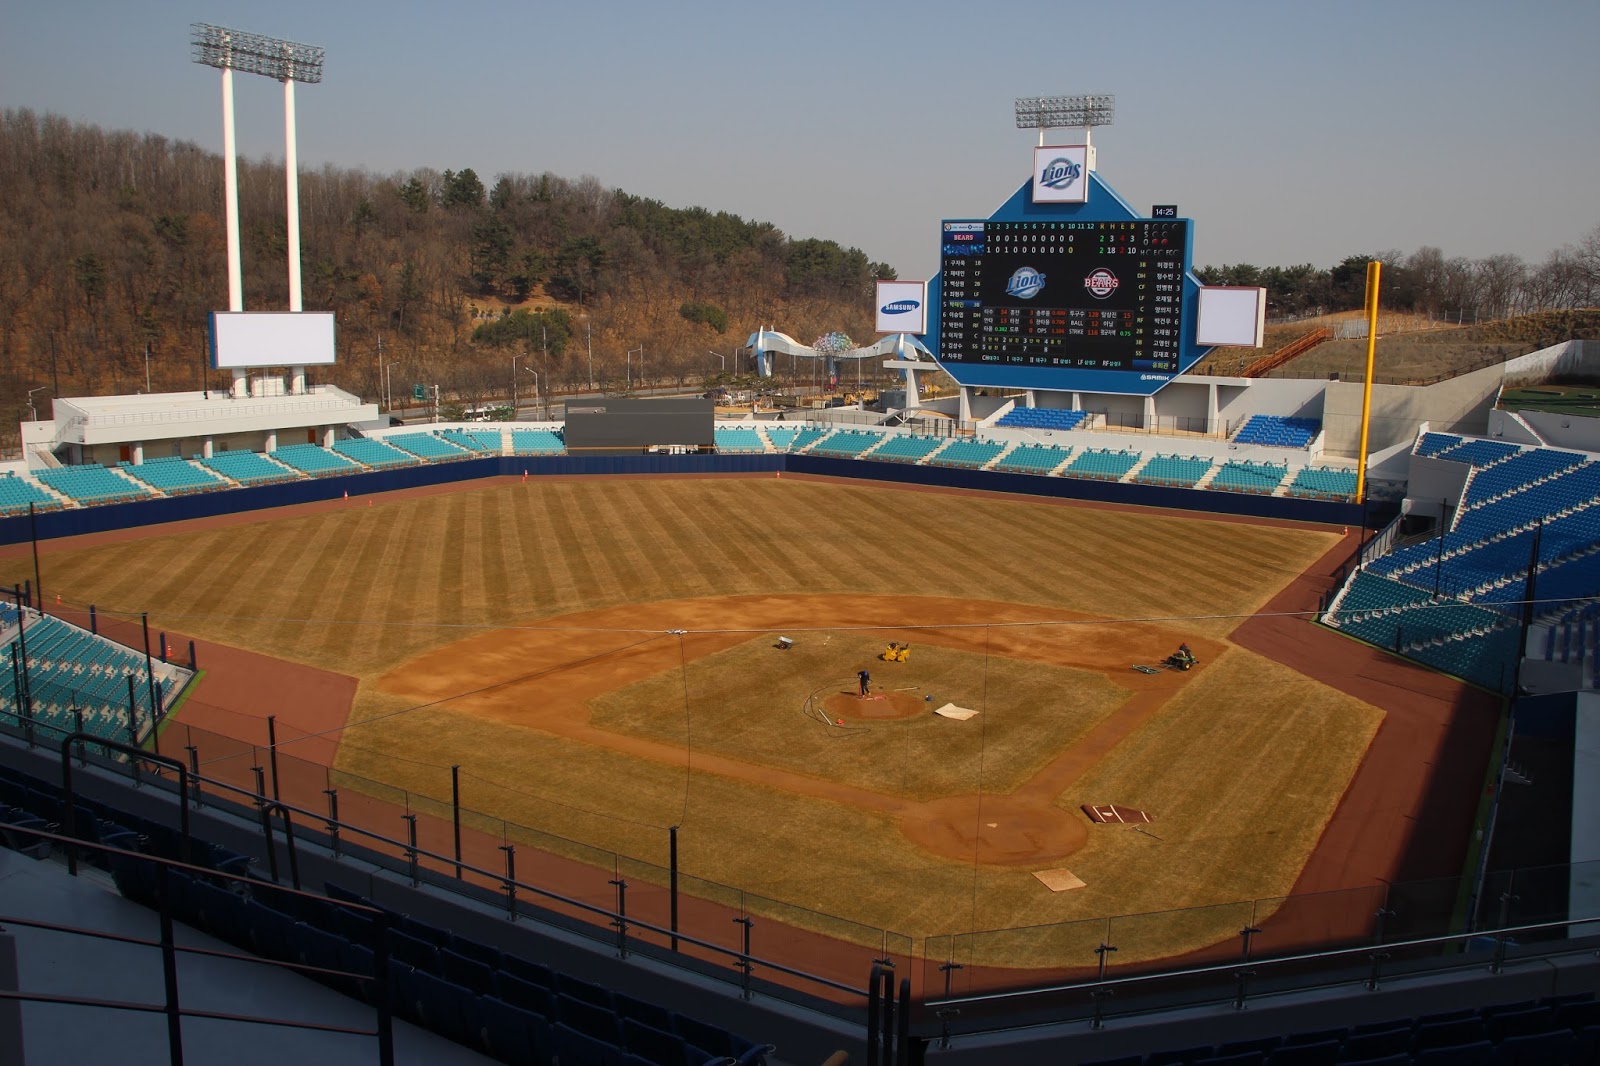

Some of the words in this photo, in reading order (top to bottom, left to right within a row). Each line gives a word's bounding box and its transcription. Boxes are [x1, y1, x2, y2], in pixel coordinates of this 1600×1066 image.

[1039, 164, 1081, 188] Lions
[1006, 273, 1046, 296] Lions
[1084, 278, 1118, 288] BEARS
